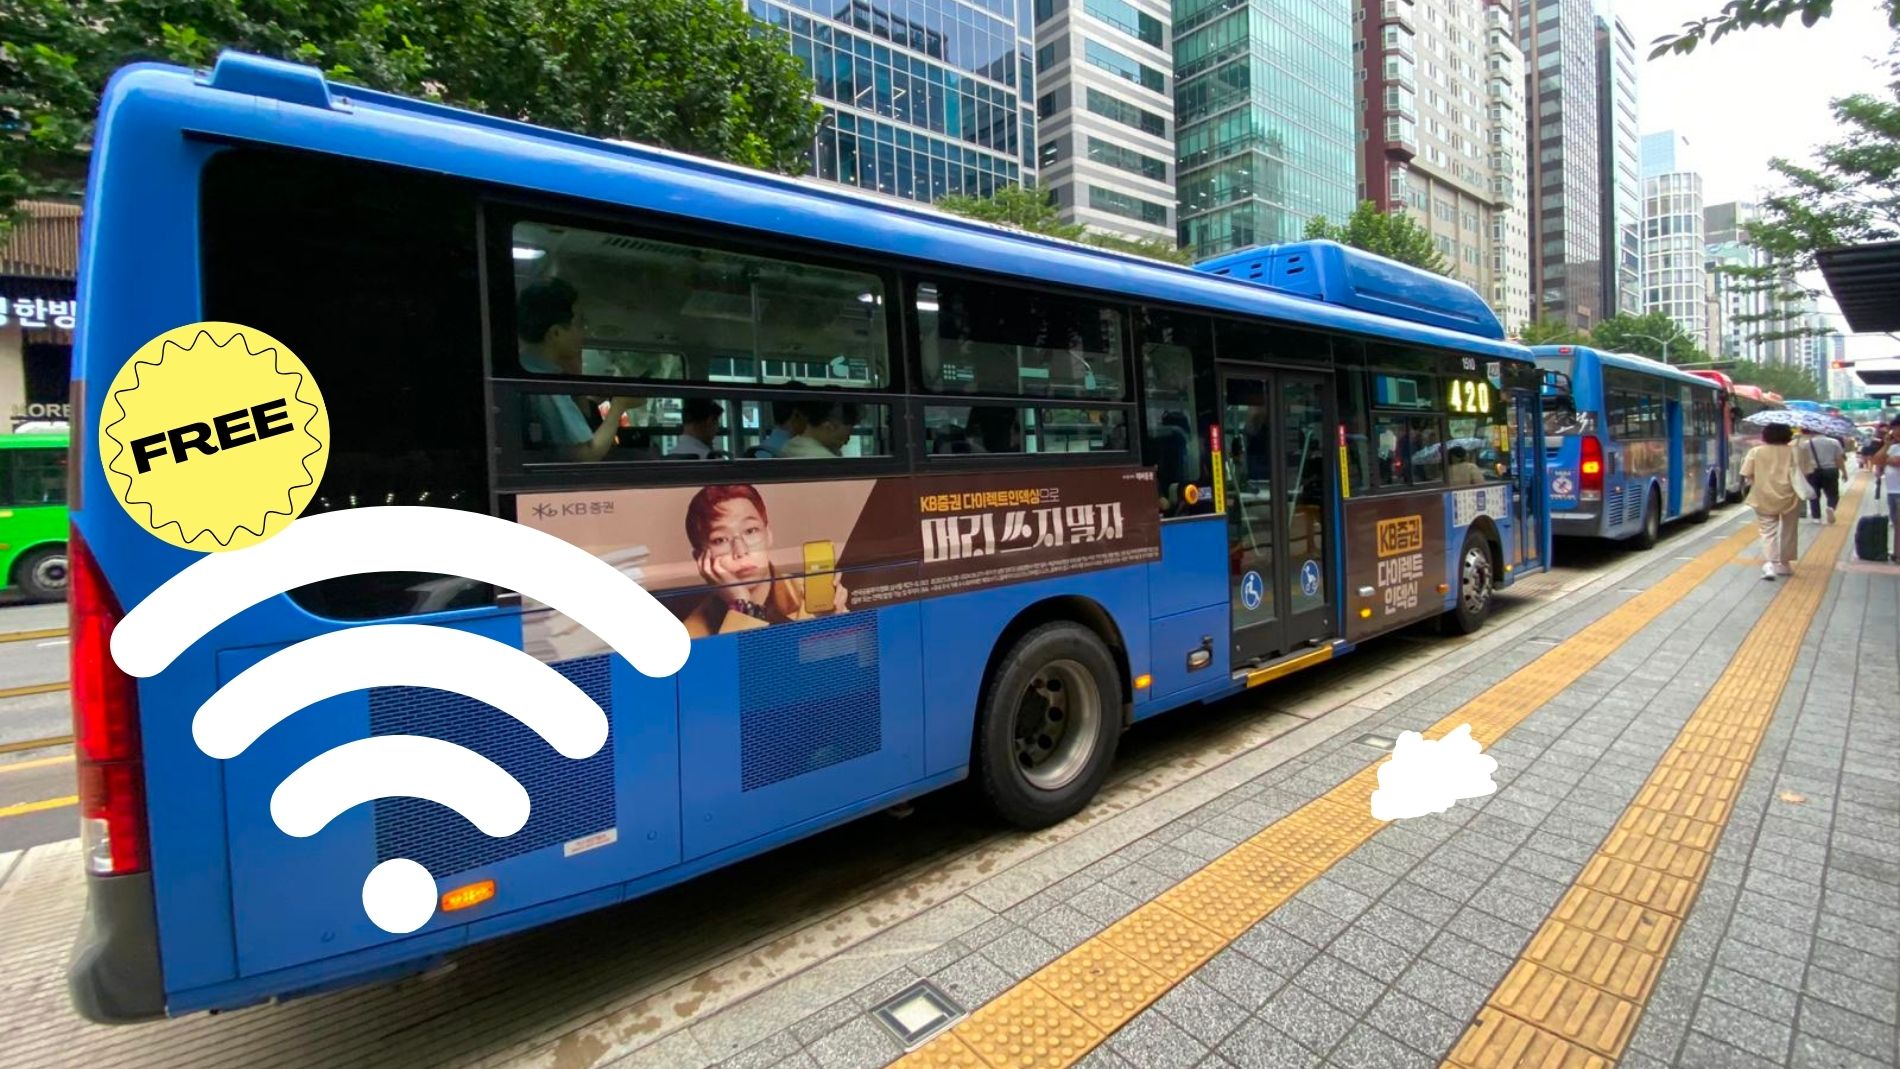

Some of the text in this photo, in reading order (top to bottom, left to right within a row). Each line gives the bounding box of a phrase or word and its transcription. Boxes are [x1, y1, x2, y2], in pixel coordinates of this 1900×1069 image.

[1451, 379, 1489, 413] 420
[921, 513, 996, 563] 머리
[1380, 518, 1420, 553] KB증권
[1377, 553, 1423, 587] 다이렉트
[1384, 580, 1418, 615] 인덱싱
